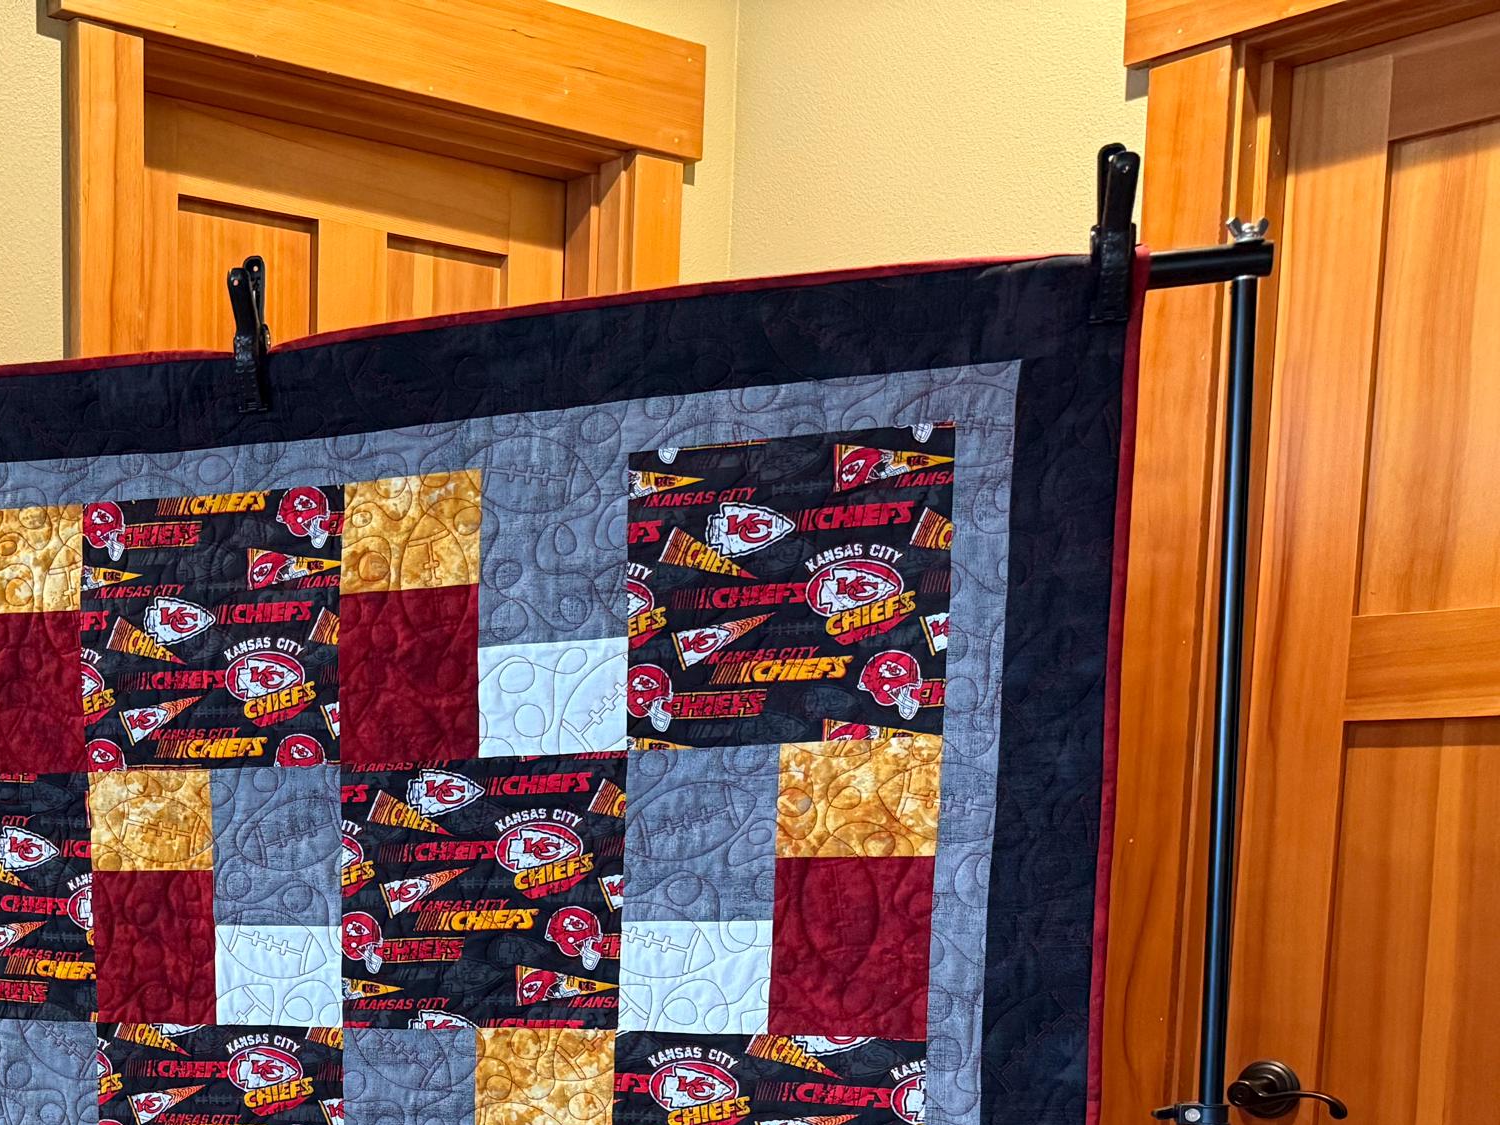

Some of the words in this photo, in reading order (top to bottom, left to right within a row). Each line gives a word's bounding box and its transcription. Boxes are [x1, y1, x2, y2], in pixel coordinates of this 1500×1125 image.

[190, 491, 271, 516] CHIEFS
[644, 490, 715, 507] KANSAS
[718, 487, 756, 500] CITY
[817, 501, 915, 530] CHIEFS
[805, 545, 863, 573] KANSAS
[869, 543, 903, 563] CITY
[99, 585, 152, 598] KANSAS
[155, 584, 184, 596] CITY
[232, 602, 313, 624] CHIEFS
[825, 592, 916, 635] CHIEFS
[224, 637, 271, 661] KANSAS
[277, 638, 303, 655] CITY
[706, 648, 778, 664] KANSAS
[782, 646, 820, 659] CITY
[752, 656, 853, 683] CHIEFS
[244, 681, 316, 718] CHIEFS
[152, 729, 207, 740] KANSAS
[210, 727, 240, 739] CITY
[186, 736, 267, 758] CHIEFS
[502, 772, 592, 795] CHIEFS
[2, 815, 30, 826] CITY
[495, 809, 546, 832] KANSAS
[553, 809, 583, 828] CITY
[514, 853, 594, 890] CHIEFS
[411, 899, 470, 911] KANSAS
[474, 899, 510, 910] CITY
[450, 909, 539, 931] CHIEFS
[355, 999, 414, 1010] KANSAS
[417, 998, 450, 1009] CITY
[226, 1034, 269, 1054] KANSAS
[274, 1035, 300, 1052] CITY
[648, 1047, 702, 1068] KANSAS
[709, 1049, 739, 1069] CITY
[244, 1077, 314, 1108] CHIEFS
